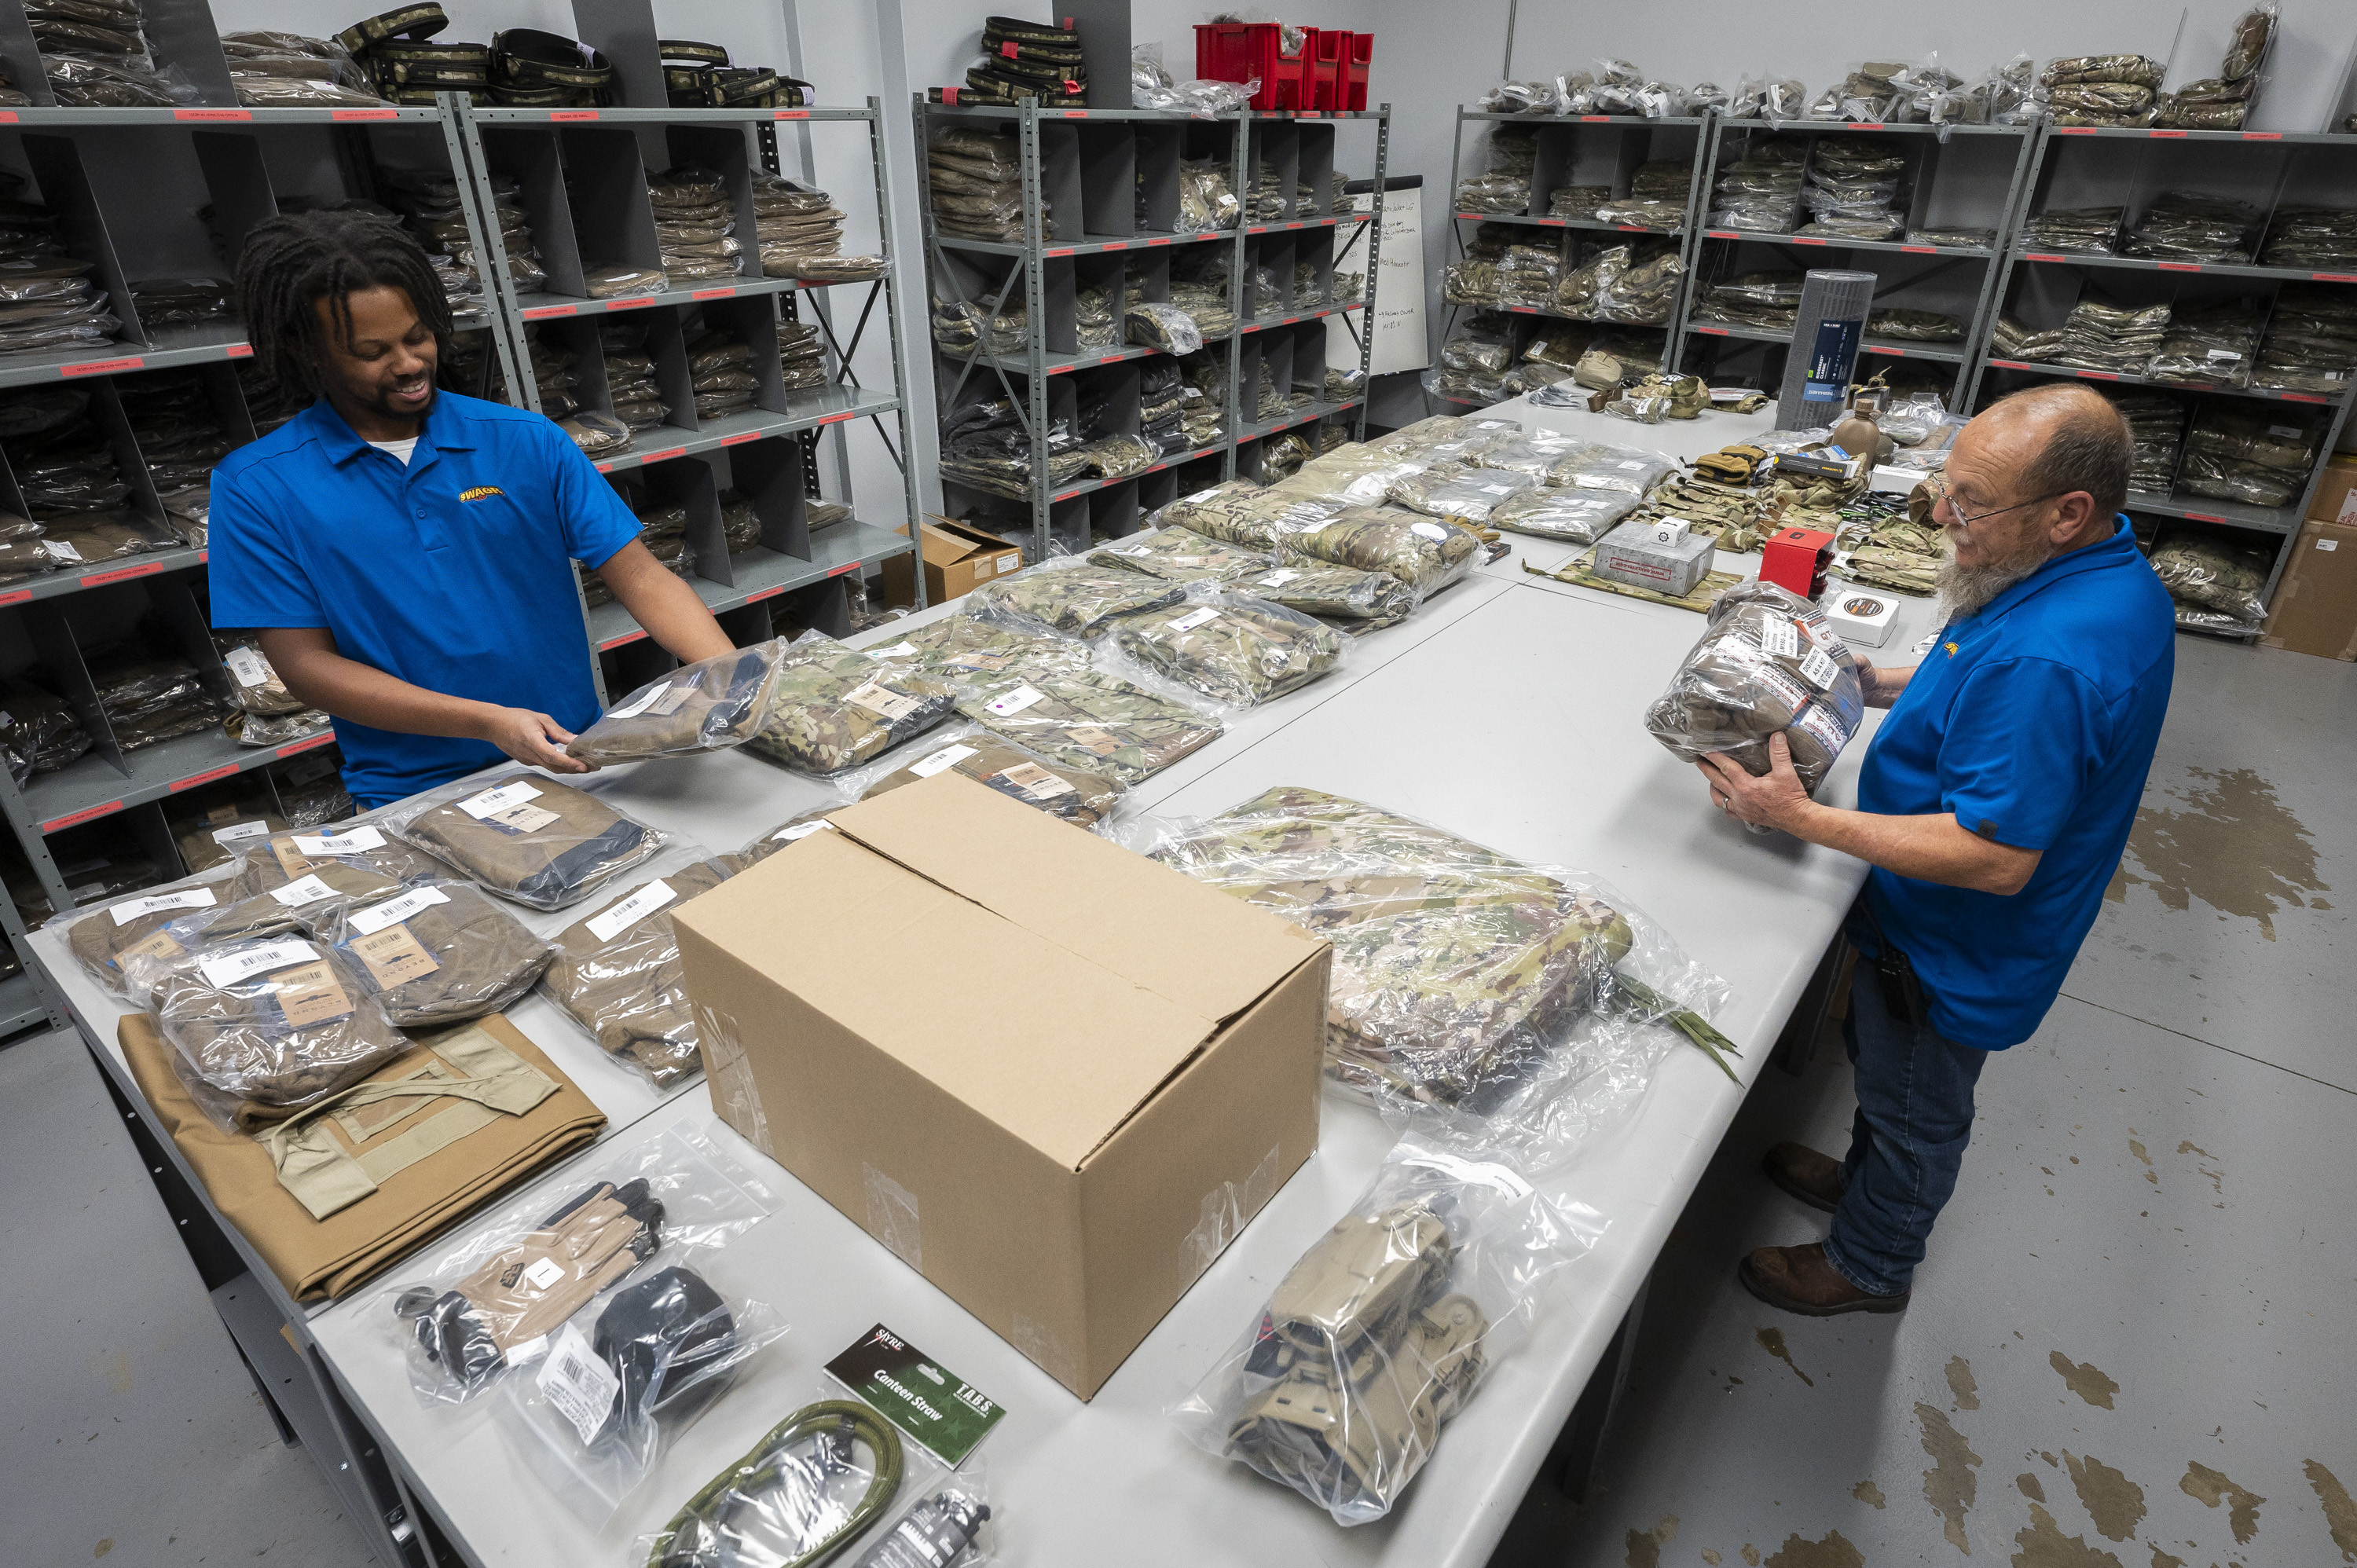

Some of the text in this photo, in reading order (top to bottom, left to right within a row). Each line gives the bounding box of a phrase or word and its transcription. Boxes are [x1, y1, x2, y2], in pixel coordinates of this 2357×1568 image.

[1803, 649, 1820, 672] DISTRIBUTE
[1813, 667, 1820, 676] AS
[382, 958, 426, 979] BEYOND
[874, 1328, 904, 1351] SAYRE
[874, 1368, 915, 1402] Canteen
[911, 1396, 943, 1421] Straw
